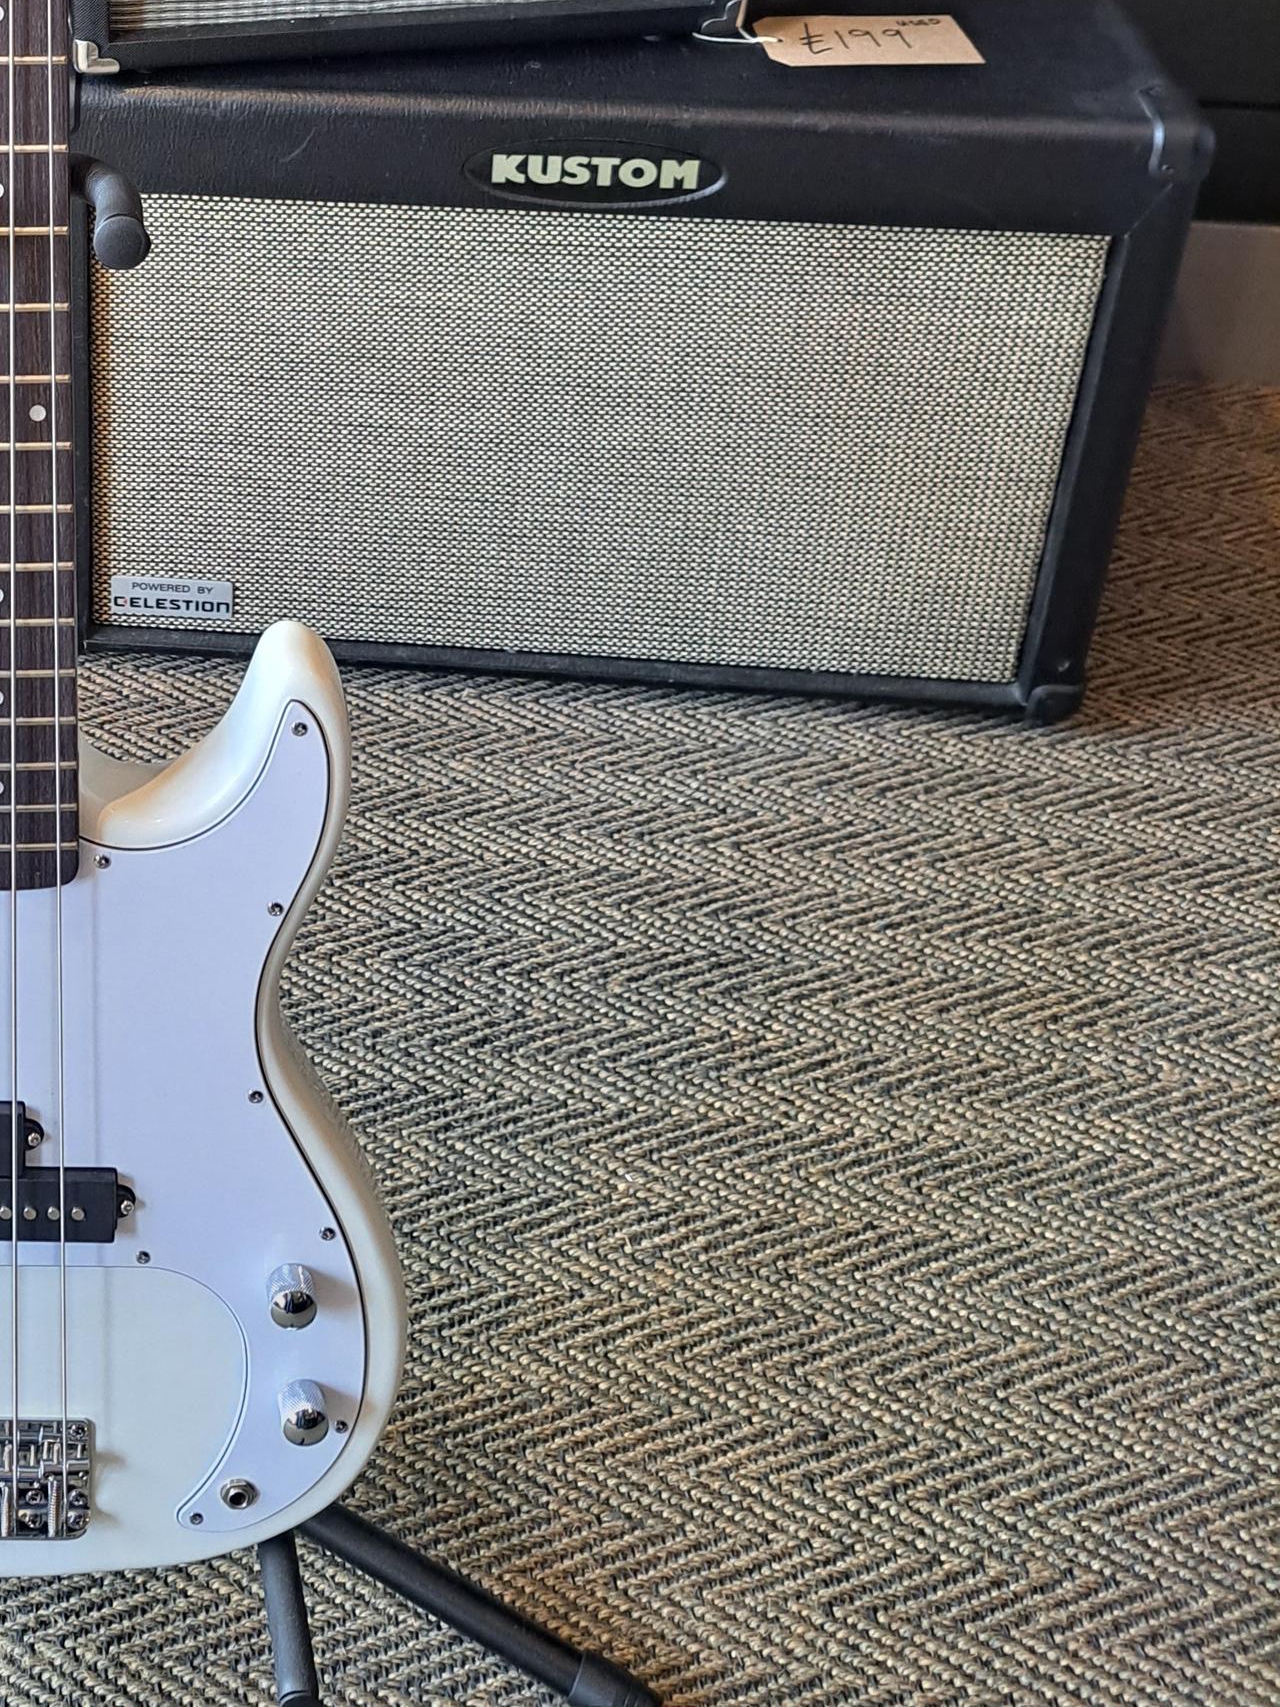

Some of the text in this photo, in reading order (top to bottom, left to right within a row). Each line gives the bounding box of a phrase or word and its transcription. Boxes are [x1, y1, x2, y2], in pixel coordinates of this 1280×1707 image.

[799, 22, 912, 55] £199
[491, 153, 702, 190] KUSTOM
[131, 581, 214, 595] POWERED BY
[113, 595, 231, 614] CELESTION
